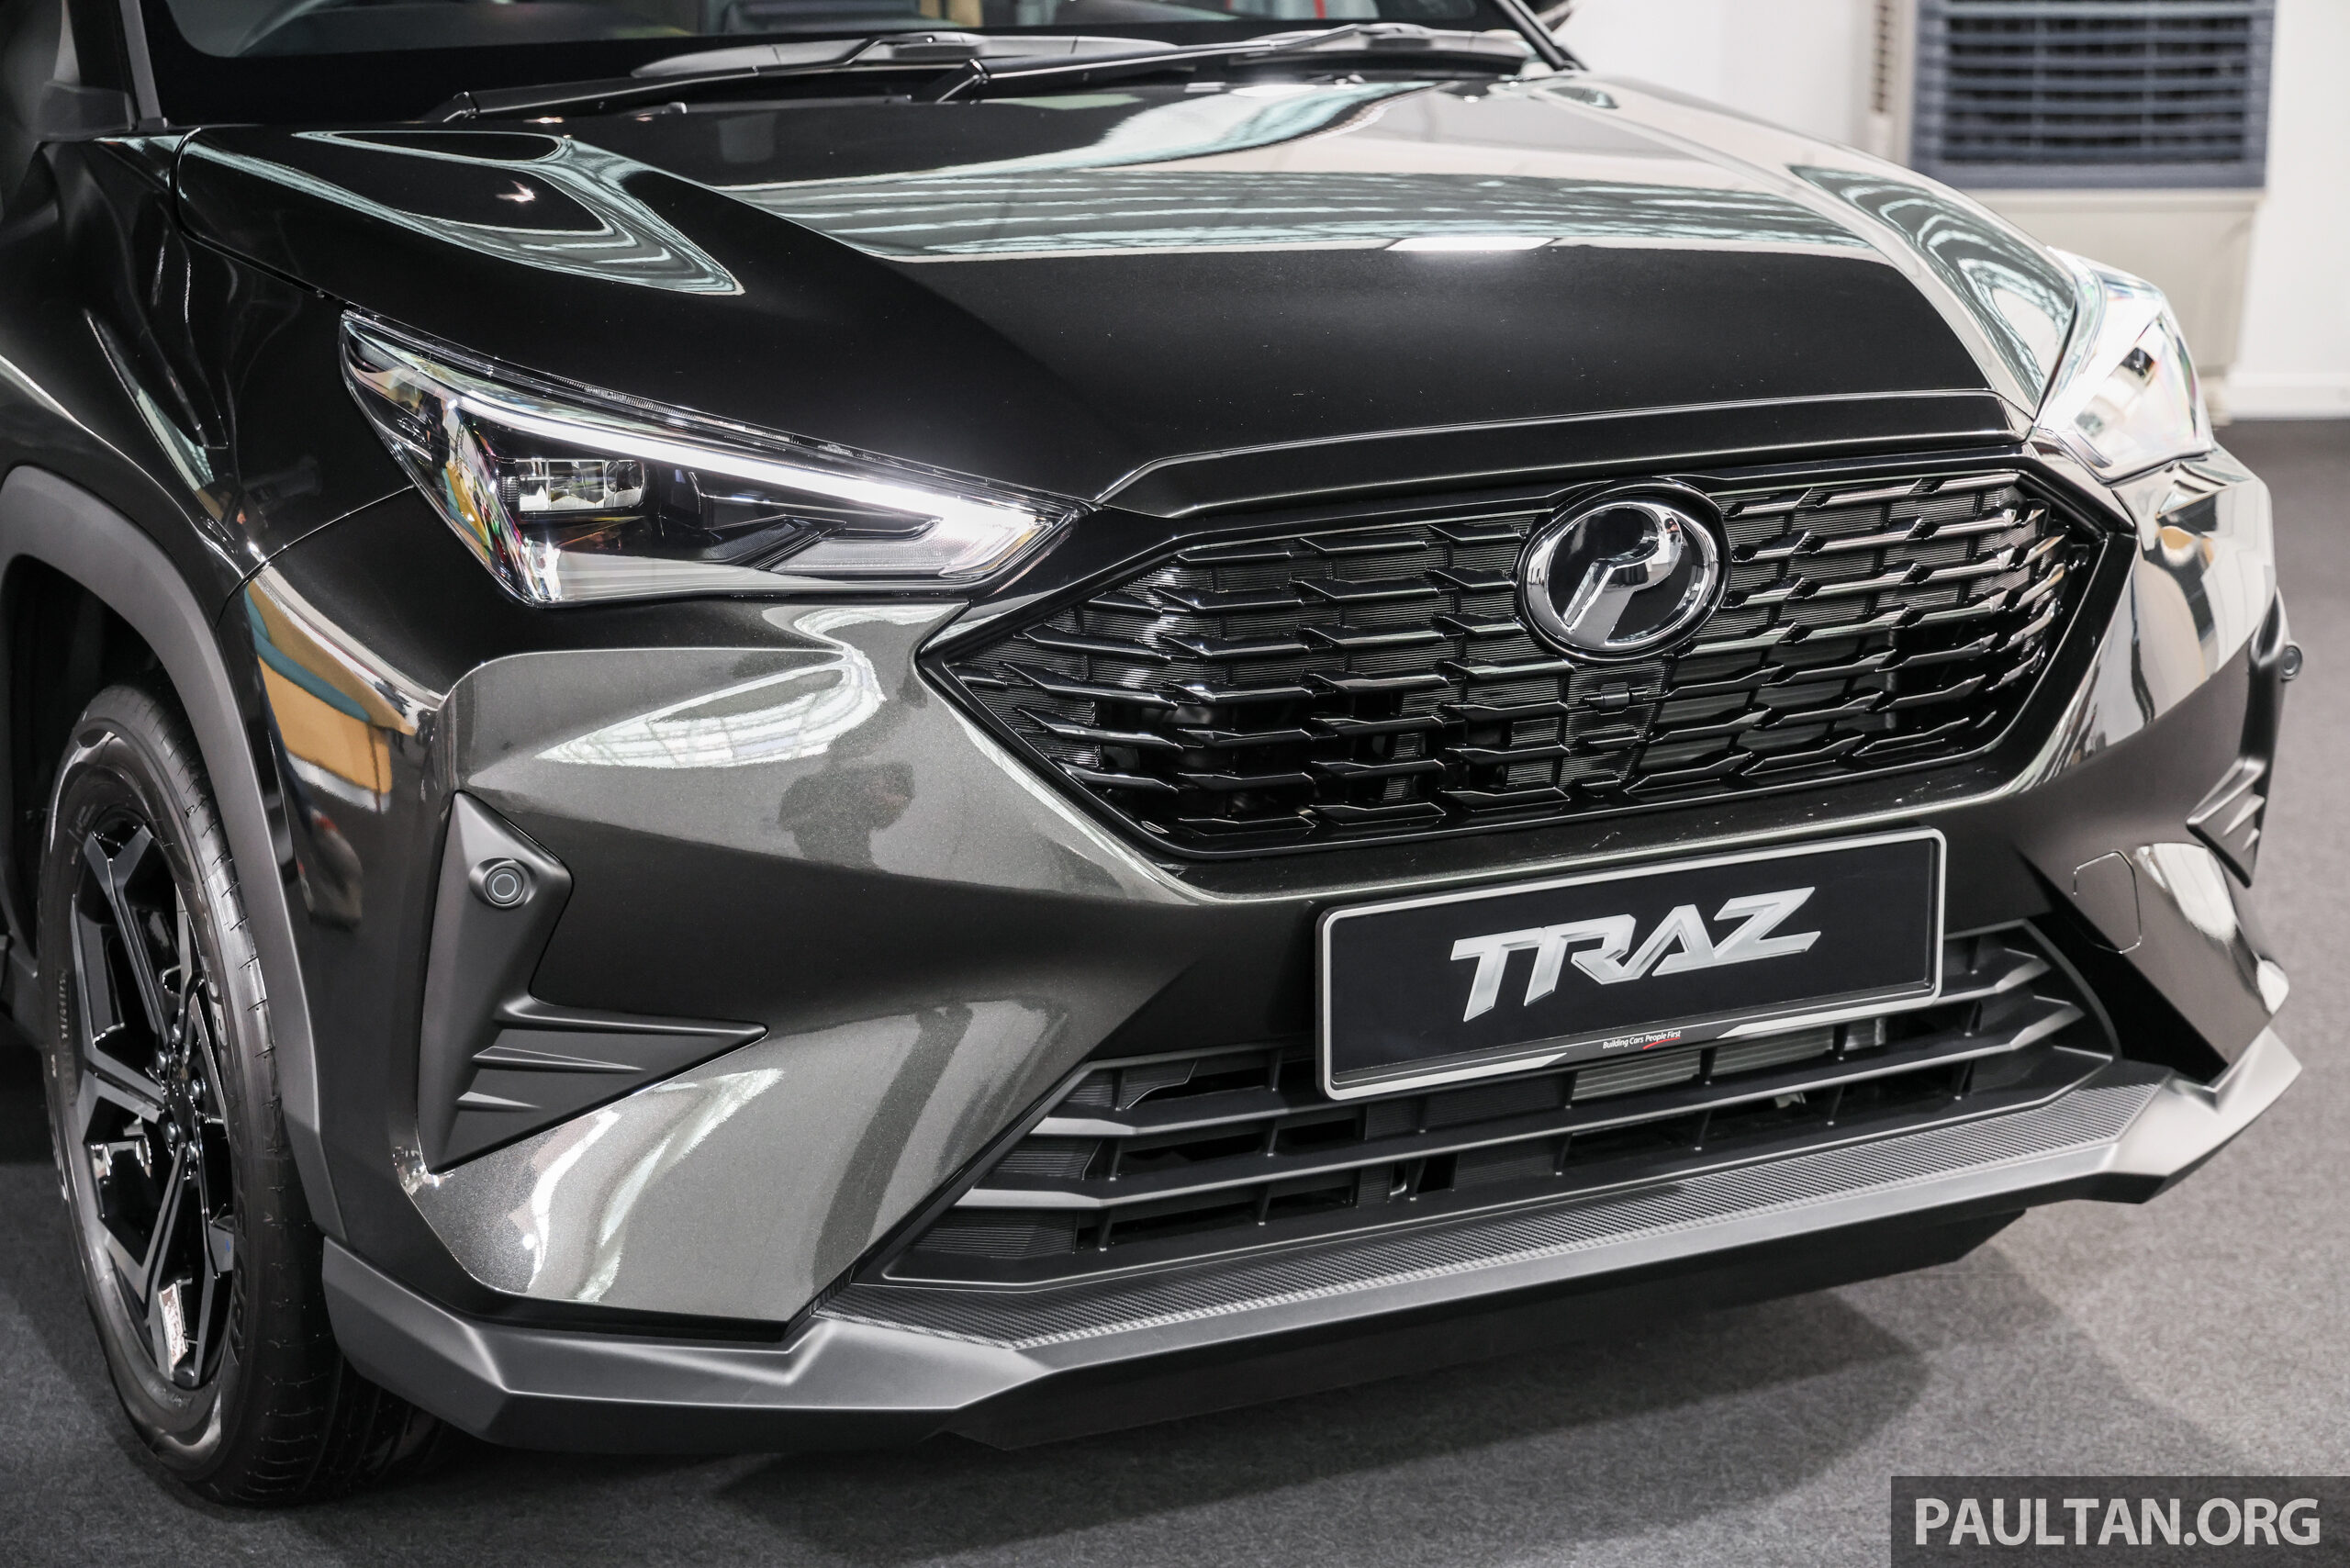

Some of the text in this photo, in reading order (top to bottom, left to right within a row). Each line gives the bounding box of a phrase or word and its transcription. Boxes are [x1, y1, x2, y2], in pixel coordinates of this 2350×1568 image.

[1450, 886, 1821, 1022] TRAZ
[1603, 1039, 1628, 1049] Building
[1645, 1033, 1667, 1042] People
[1667, 1030, 1682, 1038] First
